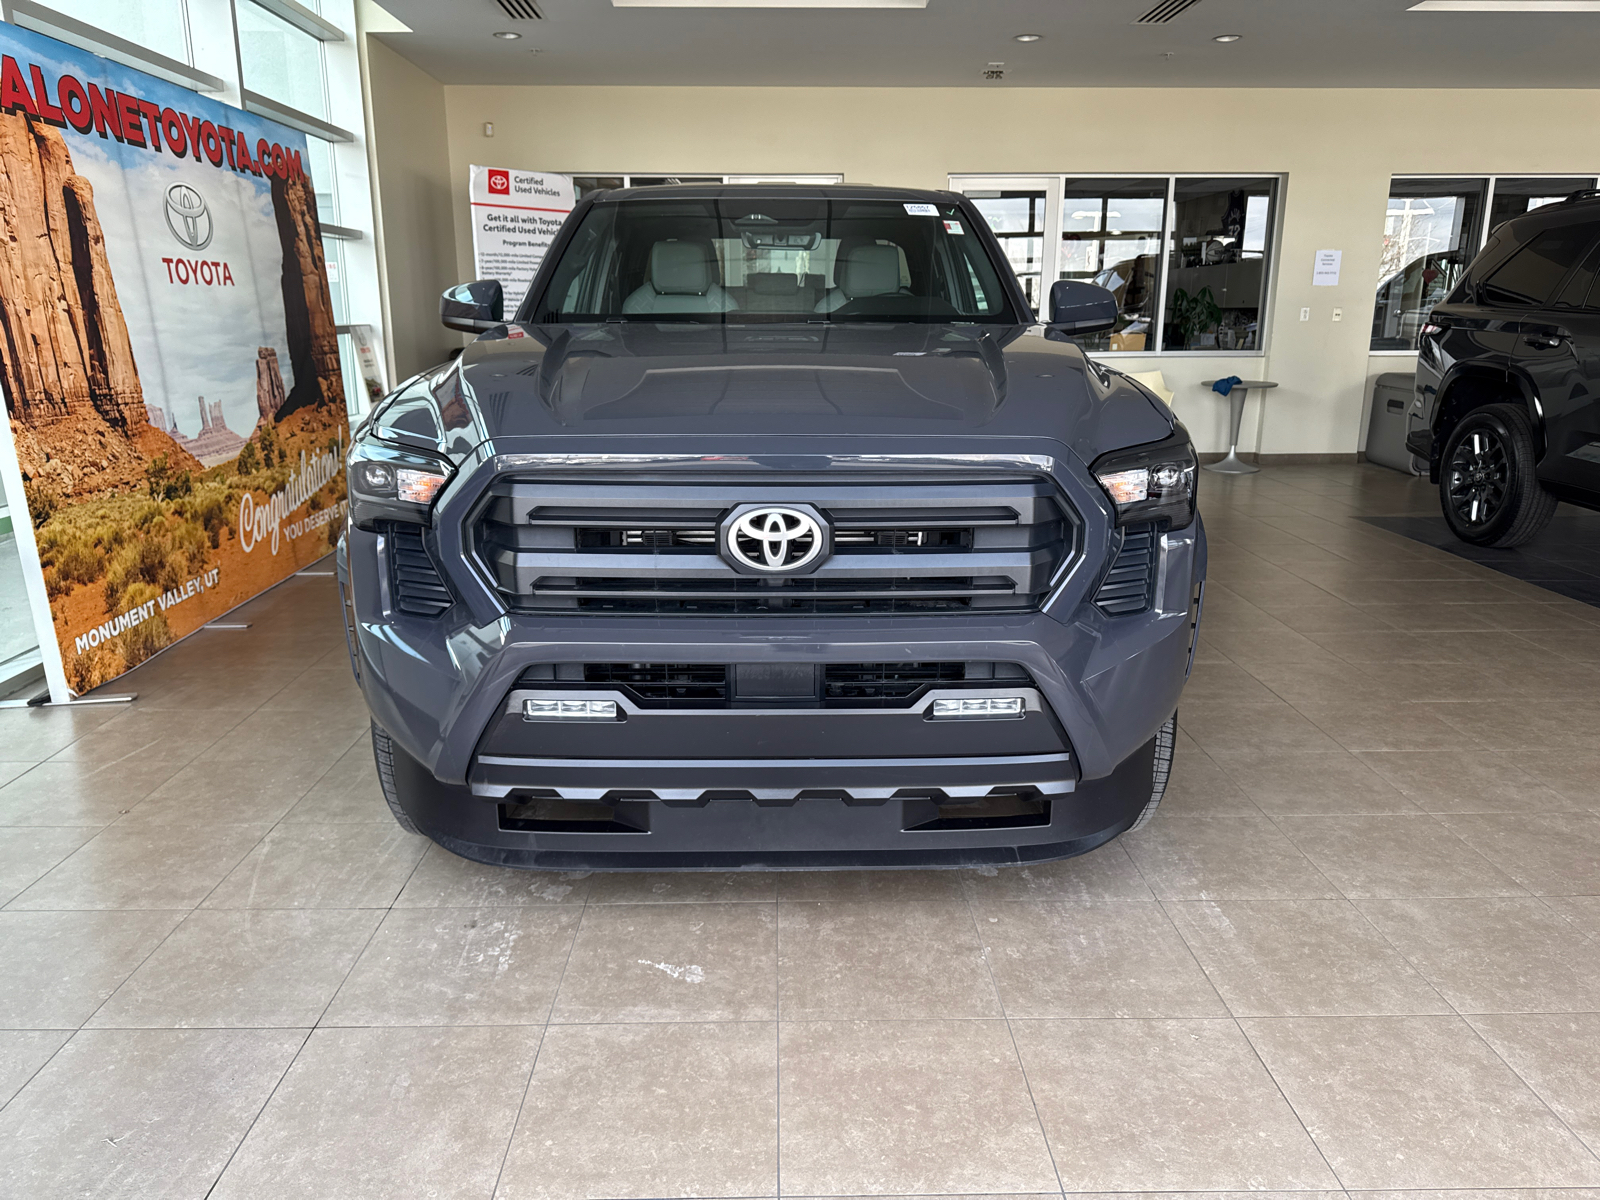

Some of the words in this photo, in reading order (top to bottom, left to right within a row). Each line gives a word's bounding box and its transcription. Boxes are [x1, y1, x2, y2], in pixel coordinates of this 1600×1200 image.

[1, 53, 304, 182] ALONETOYOTA.COM
[514, 176, 544, 186] Certified
[515, 185, 532, 194] Used
[533, 188, 561, 197] Vehicles
[483, 224, 517, 234] Certified
[518, 225, 537, 235] Used
[487, 213, 502, 223] Get
[502, 214, 508, 222] it
[510, 215, 520, 224] all
[520, 216, 537, 225] with
[538, 217, 562, 227] Toyota
[502, 239, 527, 248] Program
[161, 257, 235, 287] TOYOTA
[240, 424, 343, 556] Congratulations!
[283, 520, 303, 542] YOU
[304, 503, 340, 533] DESERVE
[74, 599, 156, 656] MONUMENT
[156, 576, 205, 612] VALLEY,
[204, 568, 220, 588] UT
